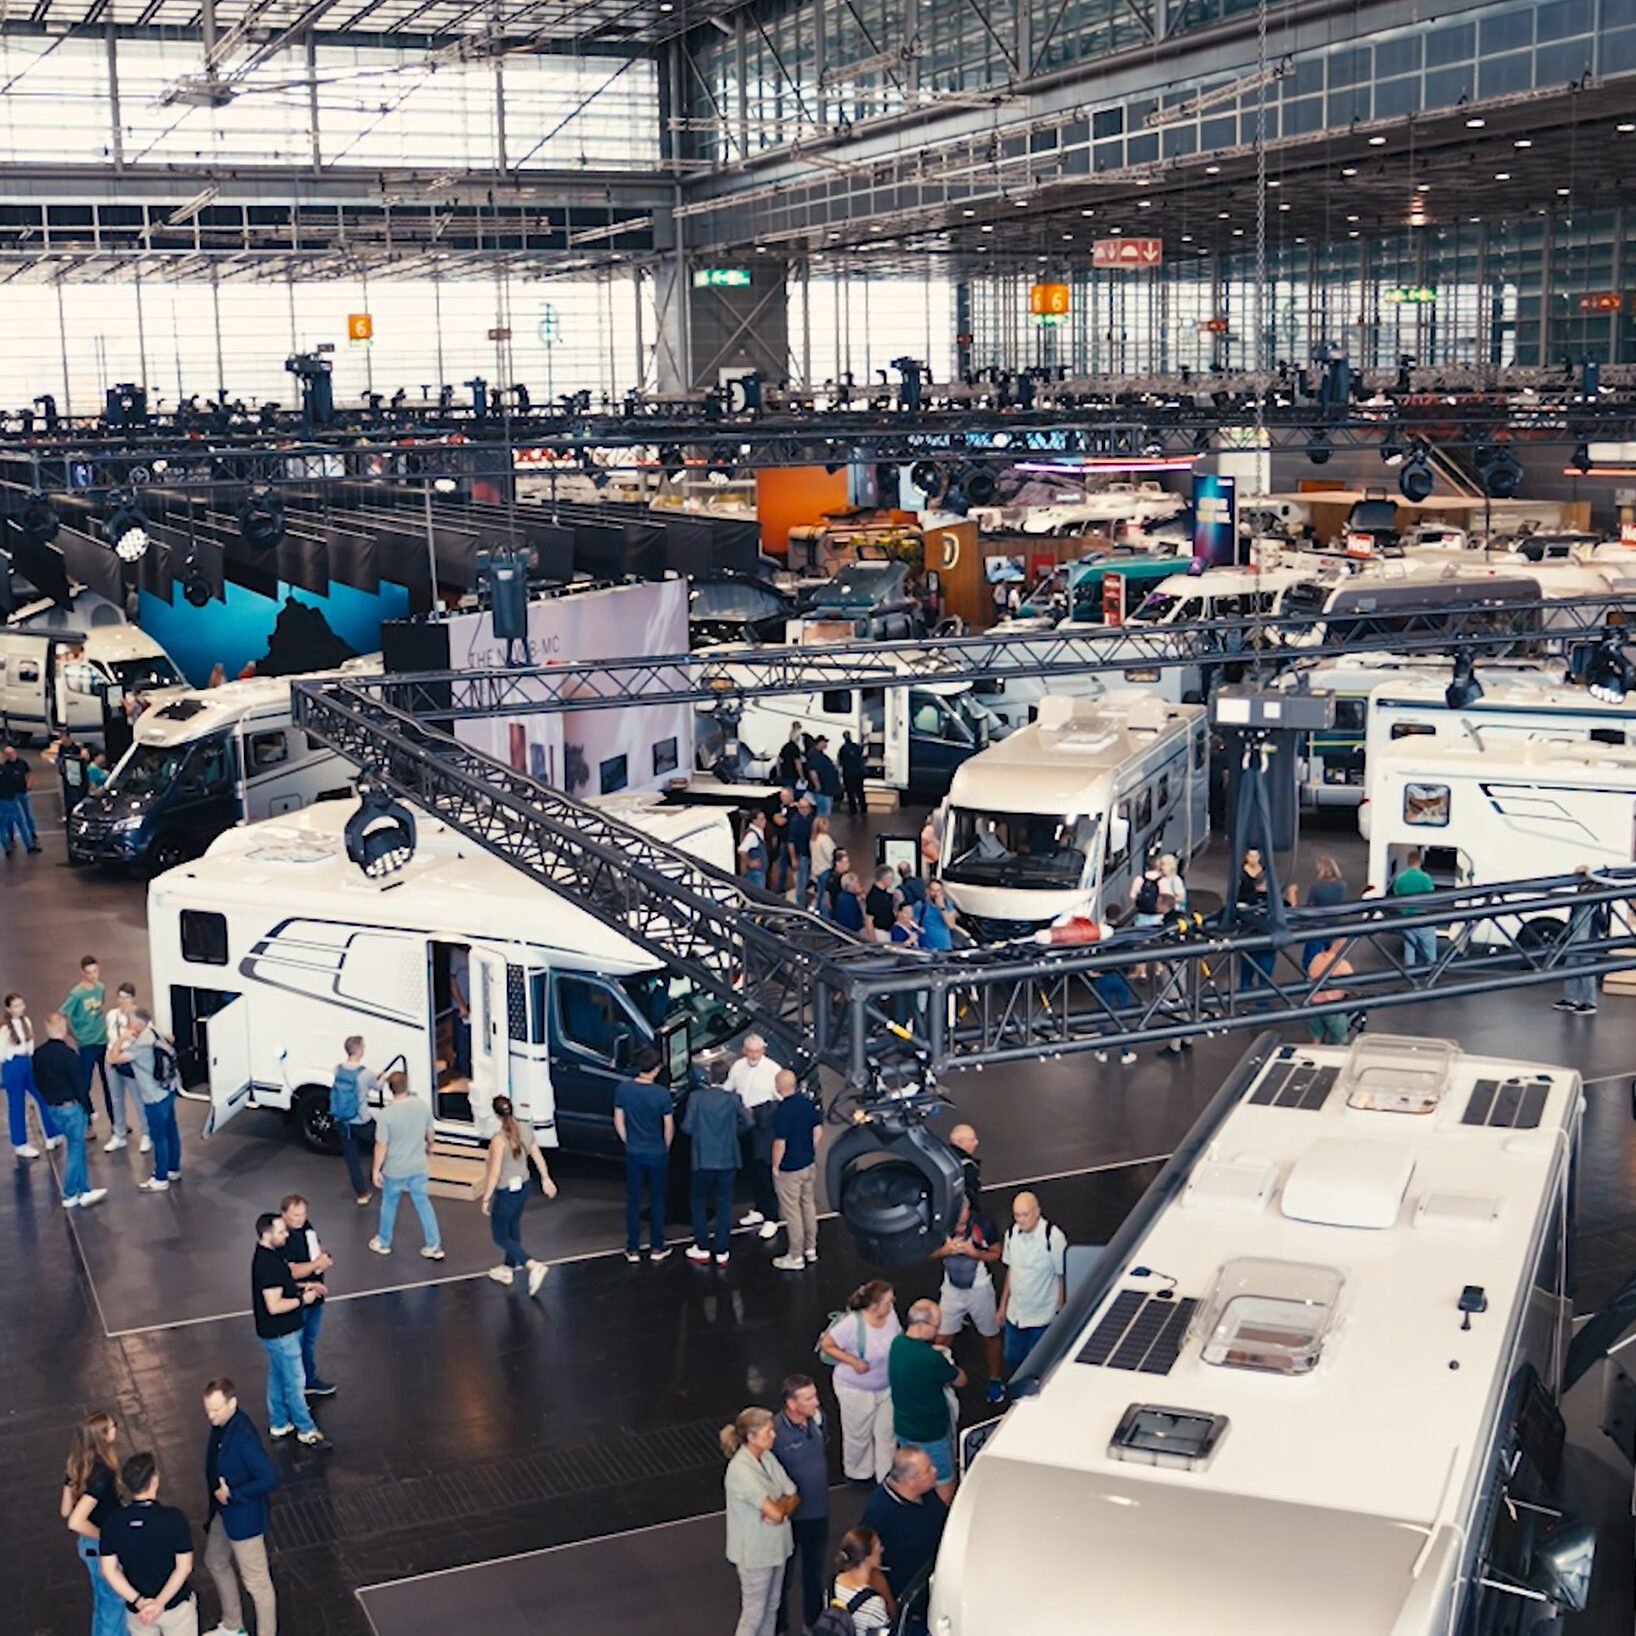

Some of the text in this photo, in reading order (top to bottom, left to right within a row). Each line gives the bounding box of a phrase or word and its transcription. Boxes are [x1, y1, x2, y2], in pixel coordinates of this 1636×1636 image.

[1051, 292, 1063, 312] 6
[355, 319, 367, 337] 6
[469, 648, 493, 669] THE
